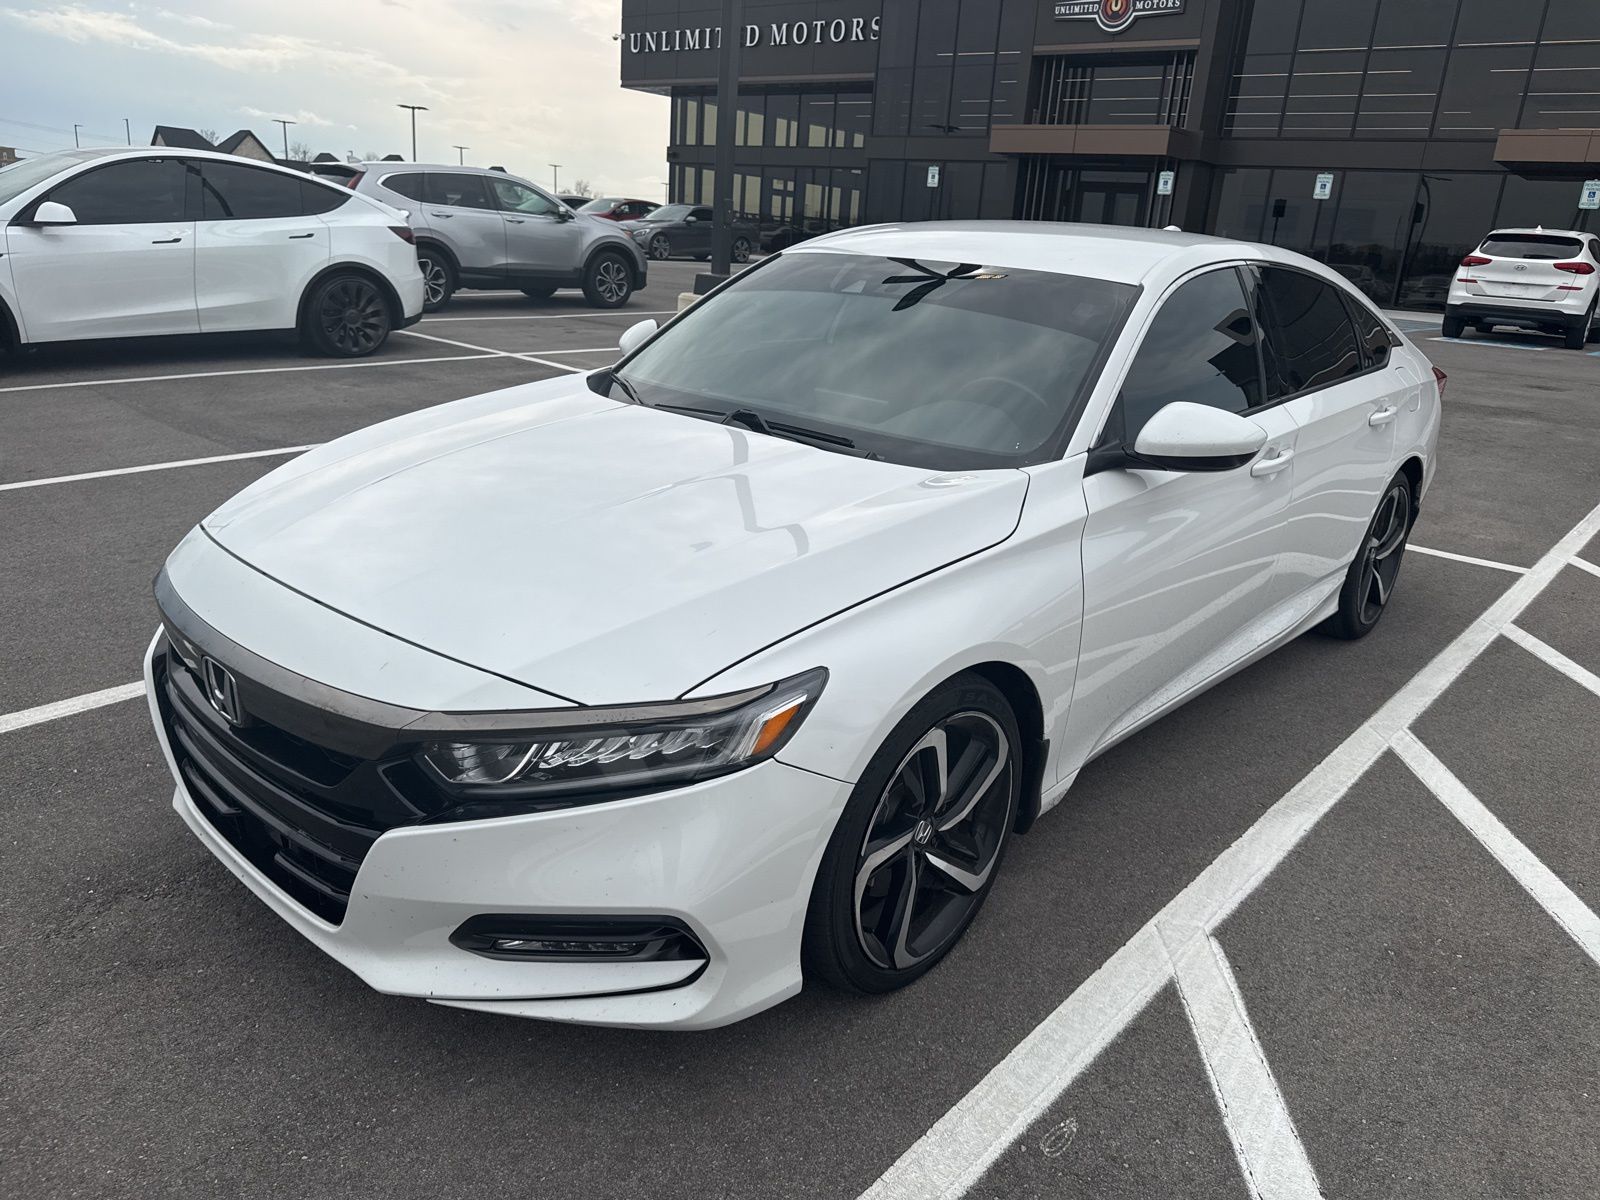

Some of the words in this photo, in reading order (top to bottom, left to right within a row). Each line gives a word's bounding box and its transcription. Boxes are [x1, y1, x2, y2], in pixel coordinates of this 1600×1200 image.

[1055, 4, 1099, 14] UNLIMITED
[1135, 0, 1180, 9] MOTORS
[630, 25, 760, 53] UNLIMITD
[769, 16, 880, 46] MOTORS
